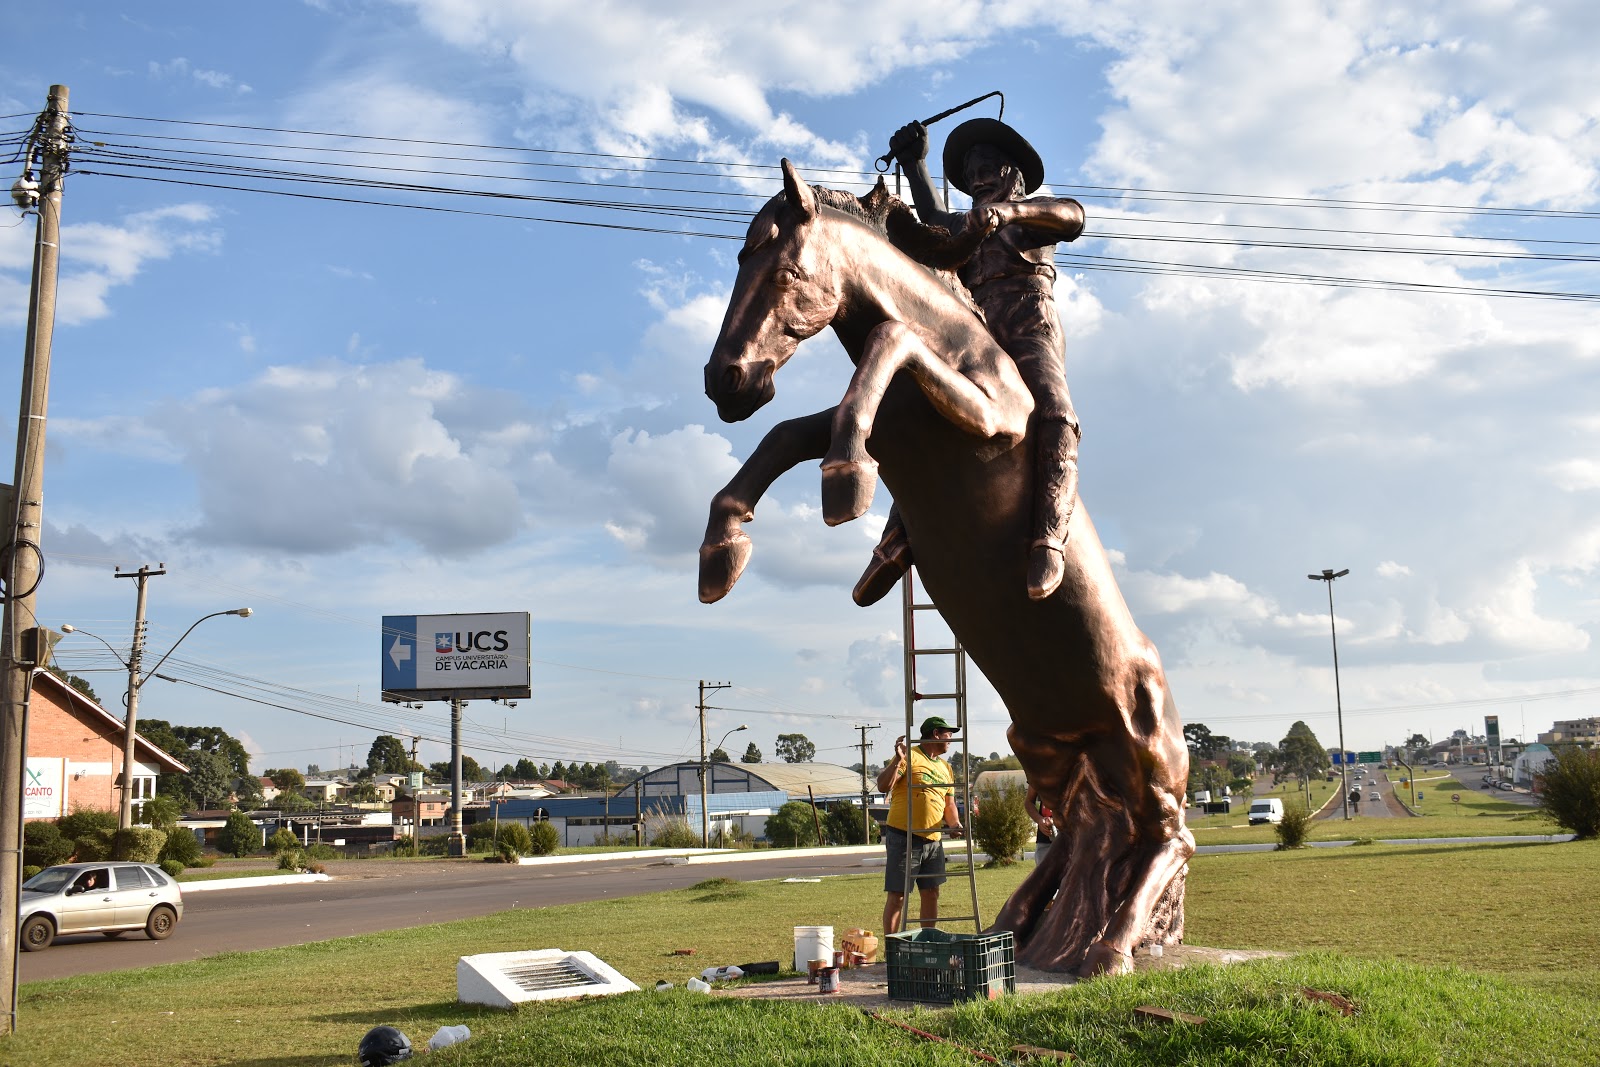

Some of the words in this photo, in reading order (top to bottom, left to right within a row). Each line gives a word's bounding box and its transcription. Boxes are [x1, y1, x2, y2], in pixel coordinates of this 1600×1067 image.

[455, 630, 508, 652] UCS
[435, 661, 451, 670] DE
[454, 660, 508, 670] VACARIA
[25, 787, 53, 796] CANTO
